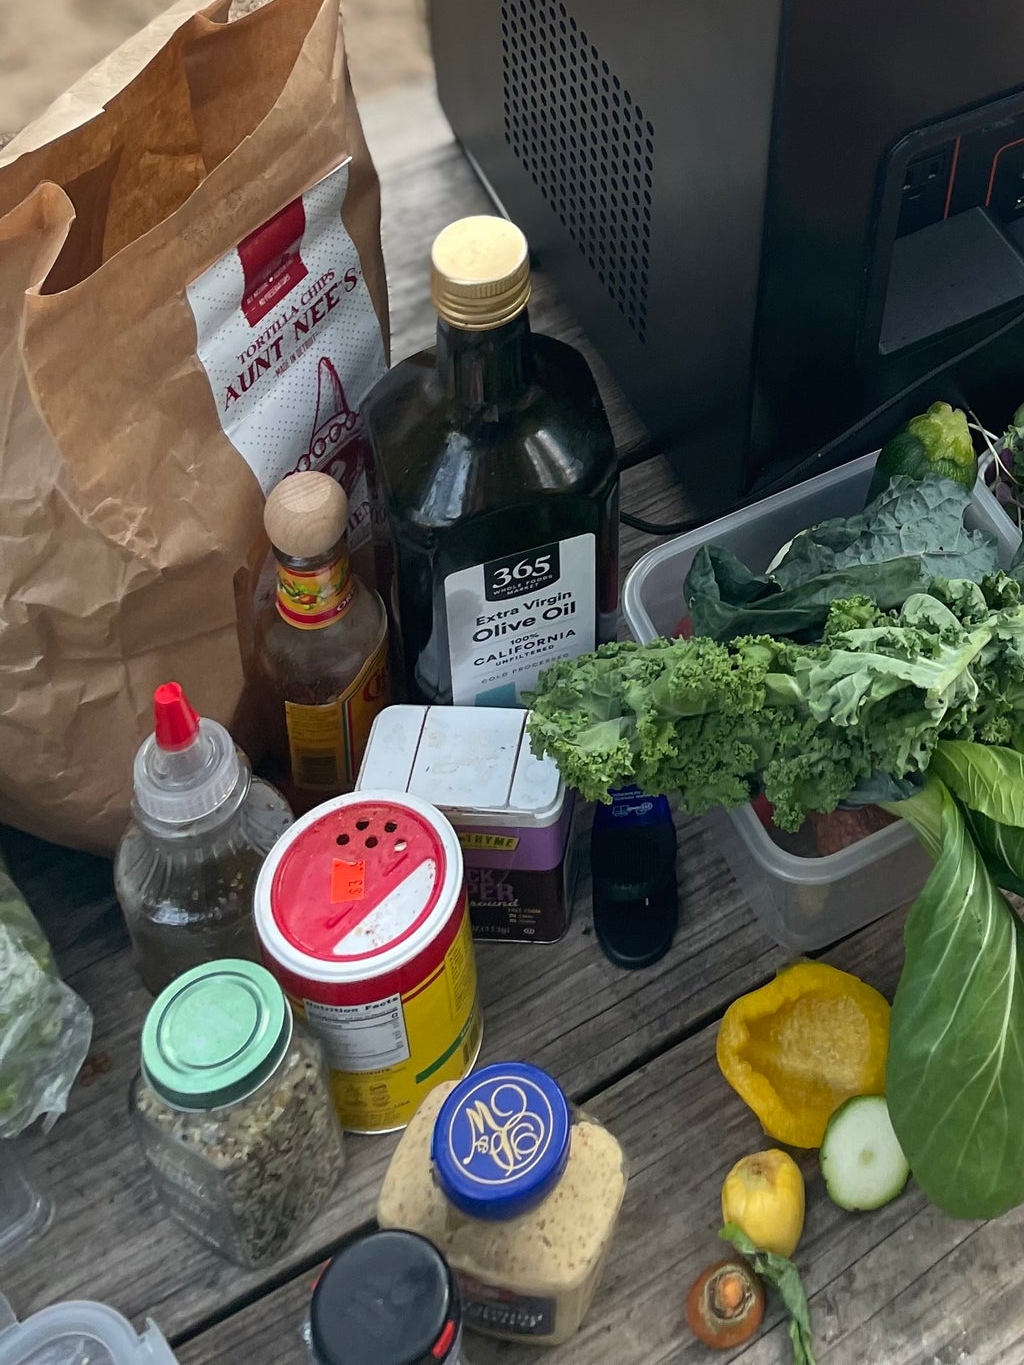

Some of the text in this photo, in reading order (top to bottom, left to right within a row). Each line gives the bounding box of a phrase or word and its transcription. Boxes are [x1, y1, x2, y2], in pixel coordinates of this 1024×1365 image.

[236, 303, 300, 366] TORTILLA
[300, 267, 336, 307] CHIPS
[224, 267, 358, 413] AUNT NEE'S
[491, 554, 552, 590] 365
[493, 574, 553, 595] WHOLE FOODS
[506, 582, 540, 596] MARKET
[472, 600, 577, 644] Olive Oil
[476, 591, 573, 627] Extra Virgin
[473, 629, 577, 667] CALIFORNIA
[495, 644, 555, 667] UNFILTERED
[509, 632, 540, 646] 100%
[480, 652, 570, 685] COLD PROCESSED
[466, 834, 515, 848] THYME
[305, 995, 399, 1013] Nutrition Facts
